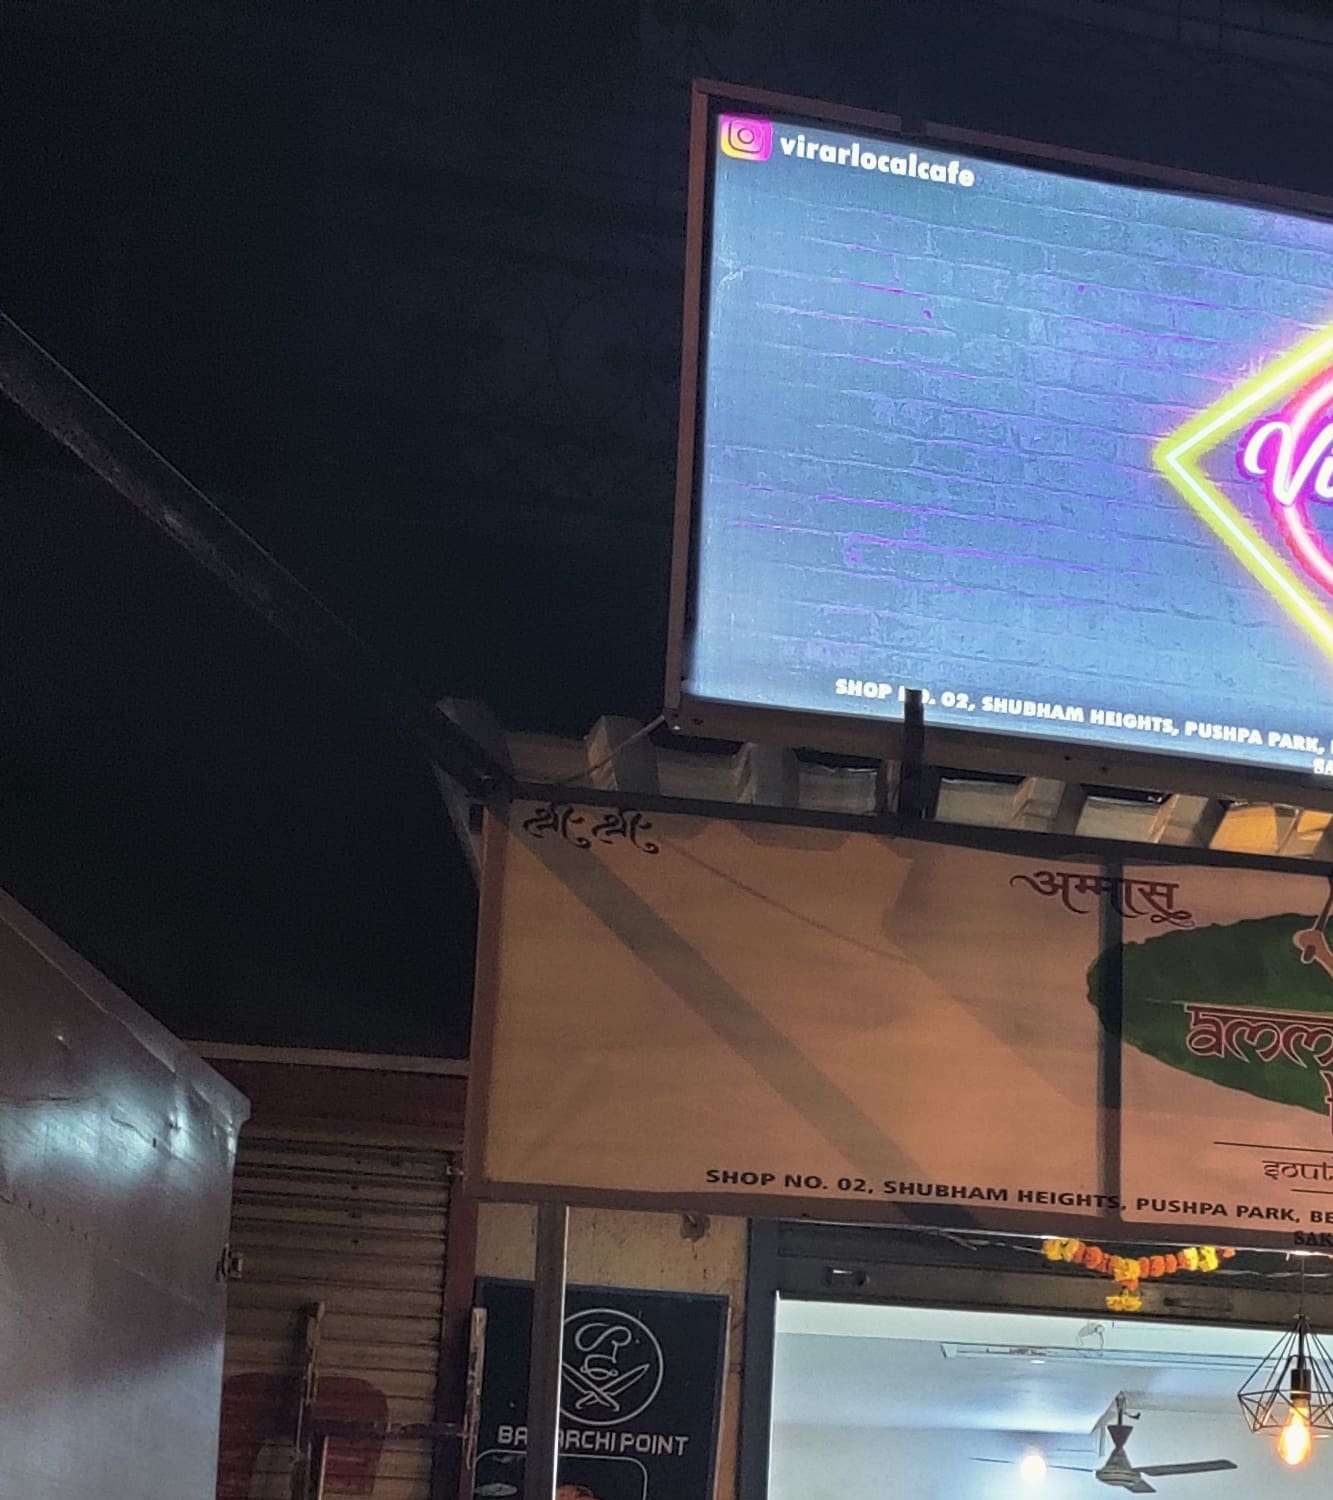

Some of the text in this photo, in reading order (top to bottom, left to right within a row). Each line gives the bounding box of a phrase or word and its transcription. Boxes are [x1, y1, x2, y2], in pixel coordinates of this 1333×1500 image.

[779, 132, 976, 188] virarlocalcafe
[834, 678, 893, 701] SHOP
[940, 690, 976, 713] 02,
[981, 695, 1086, 724] SHUBHAM
[1090, 708, 1180, 738] HEIGHTS,
[1184, 721, 1263, 746] PUSHPA
[1268, 732, 1326, 757] PARK,
[705, 1167, 777, 1188] SHOP
[783, 1173, 829, 1192] NO.
[836, 1176, 875, 1196] 02,
[882, 1179, 1009, 1202] SHUBHAM
[1017, 1188, 1127, 1213] HEIGHTS,
[1135, 1197, 1229, 1219] PUSHPA
[1235, 1204, 1302, 1225] PARK,
[619, 1432, 690, 1457] POINT
